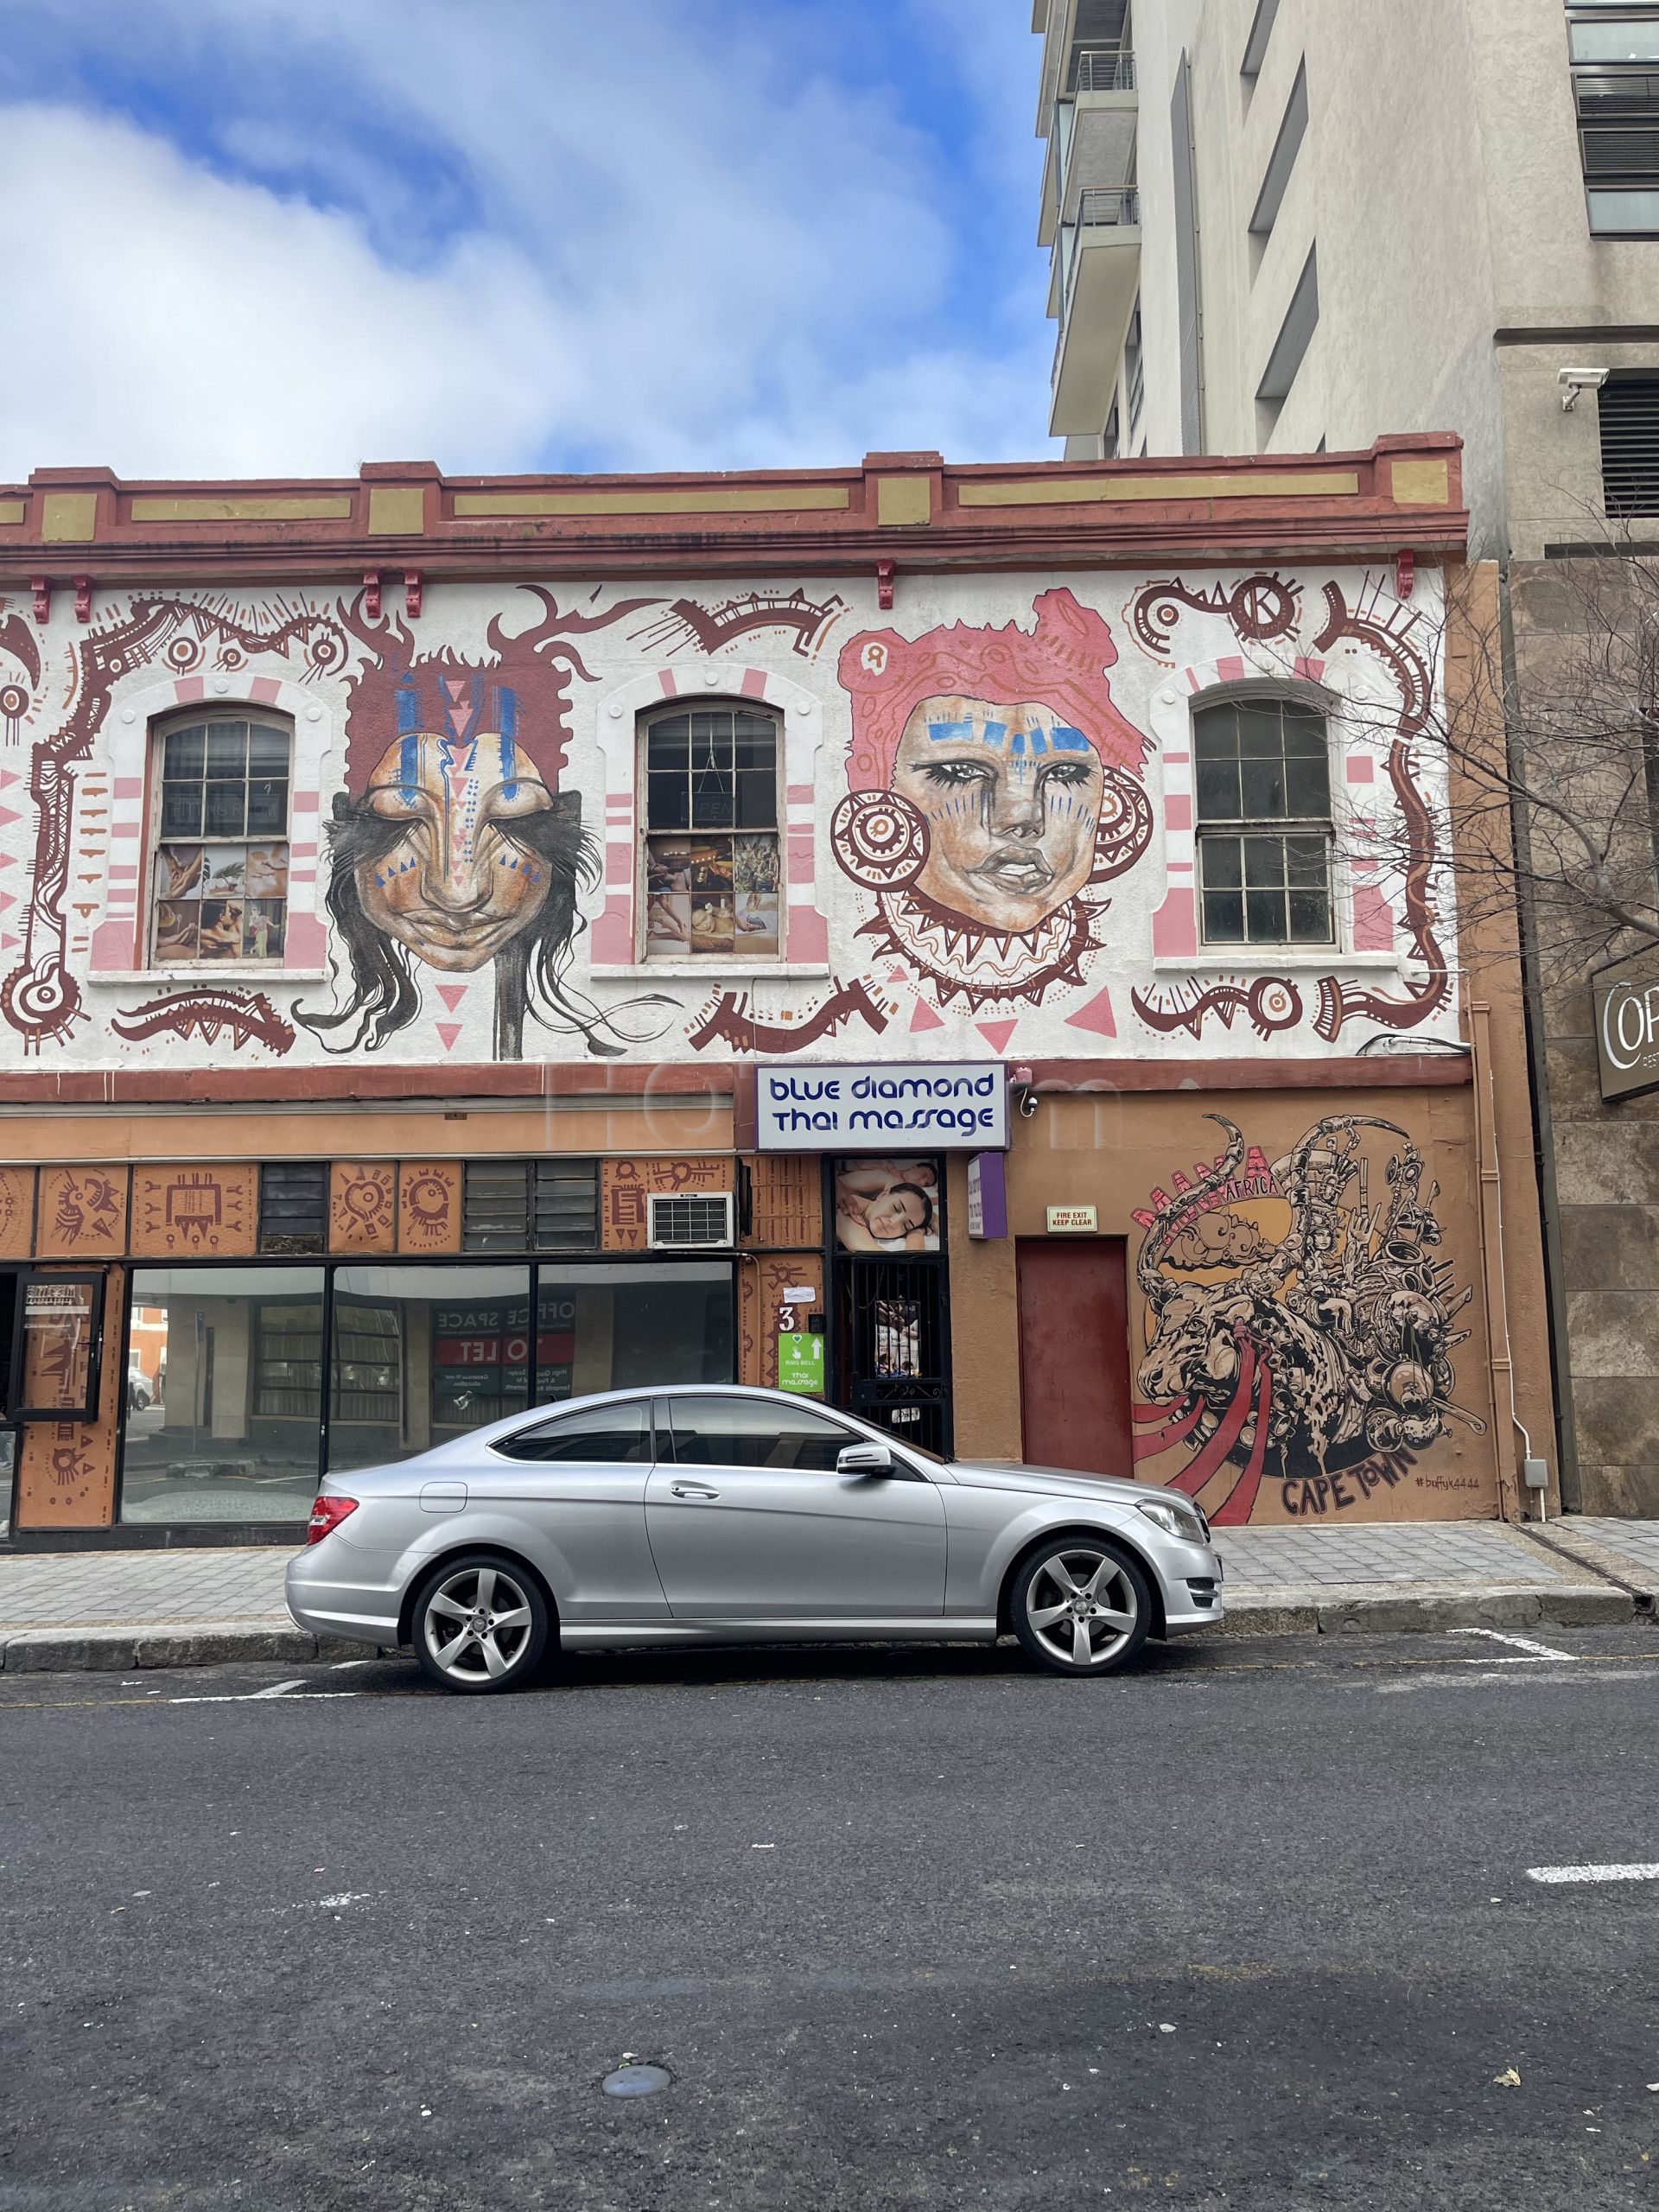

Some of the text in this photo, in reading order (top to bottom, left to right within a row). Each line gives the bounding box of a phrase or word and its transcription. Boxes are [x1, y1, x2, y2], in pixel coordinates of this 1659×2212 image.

[174, 802, 276, 817] FITTNG ROM
[851, 1072, 994, 1099] diamond
[772, 1107, 994, 1137] Thai massage
[1225, 1175, 1279, 1201] AFRICA
[779, 1306, 795, 1332] 3
[1281, 1446, 1418, 1516] CAPE TOWN
